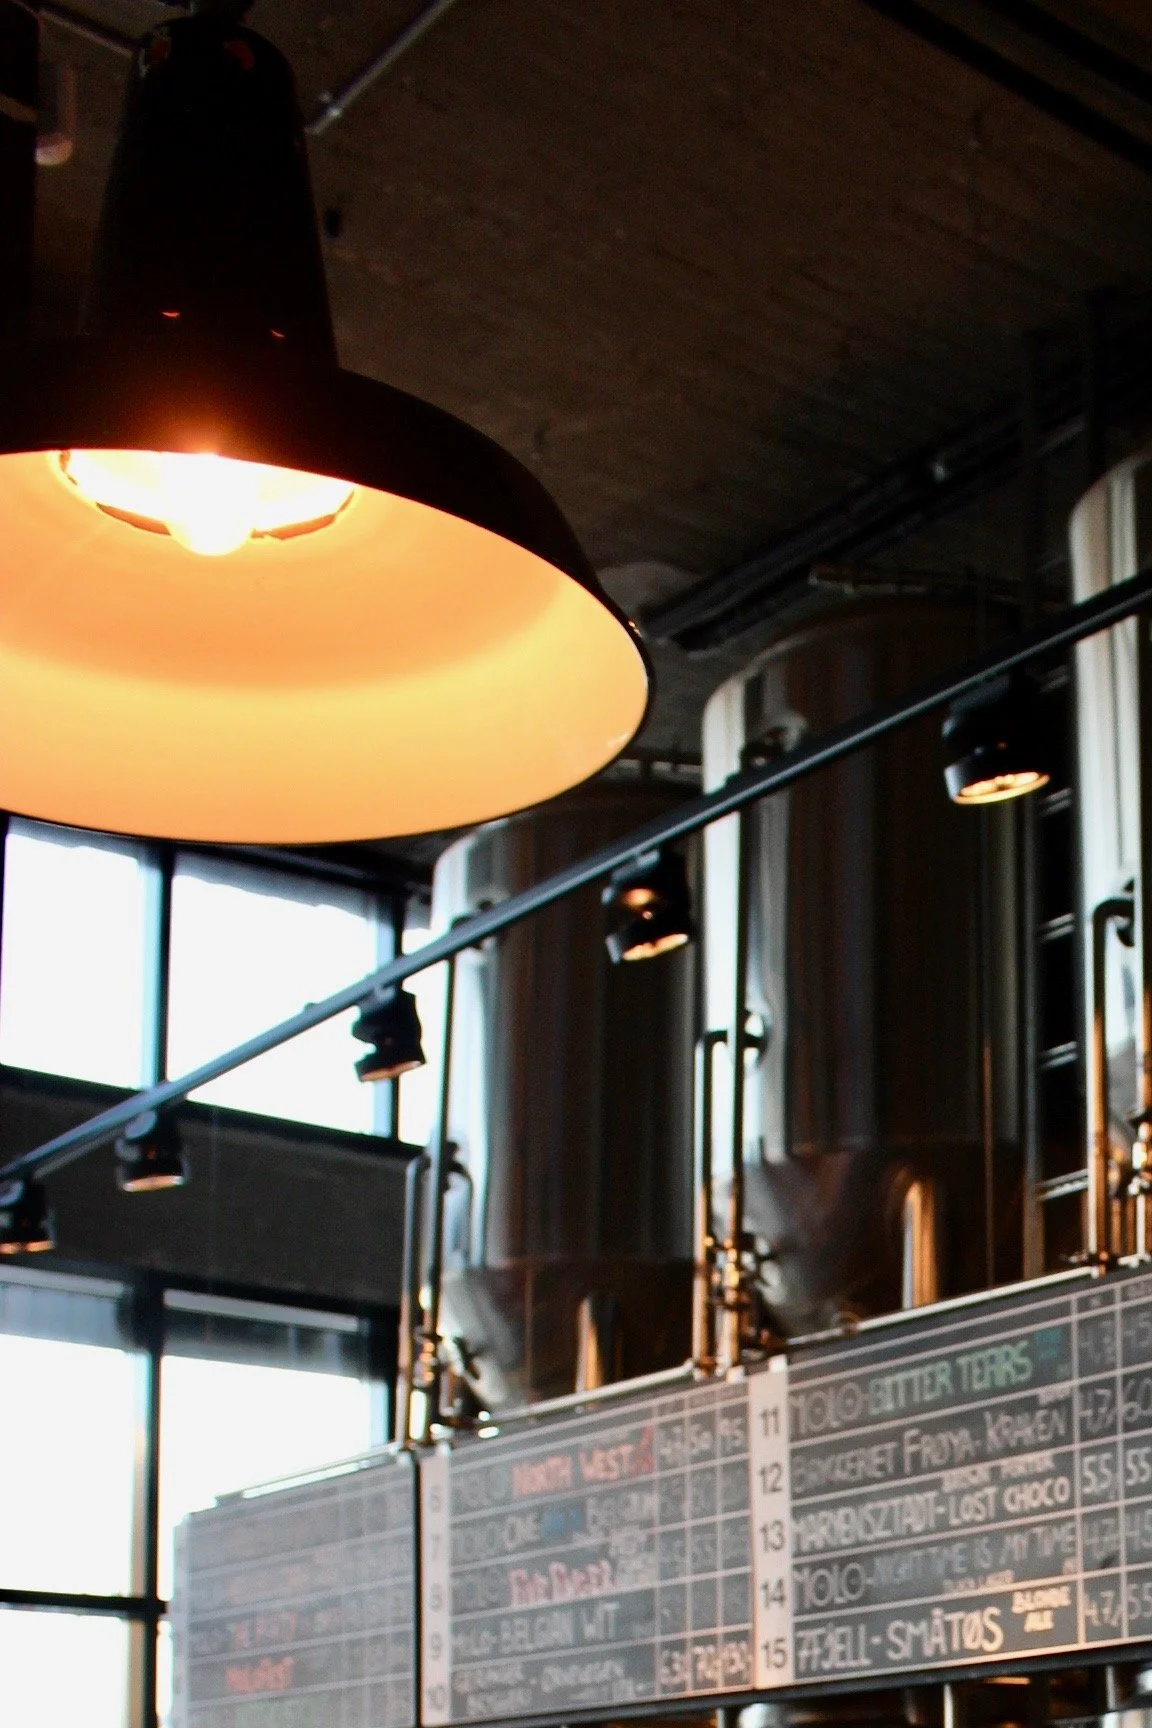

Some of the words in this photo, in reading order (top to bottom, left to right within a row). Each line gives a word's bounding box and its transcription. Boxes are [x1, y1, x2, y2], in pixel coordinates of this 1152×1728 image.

[868, 1360, 954, 1416] BITTER
[759, 1405, 780, 1437] 11
[759, 1462, 782, 1494] 12
[760, 1520, 785, 1551] 13
[761, 1577, 786, 1611] 14
[761, 1637, 787, 1669] 15
